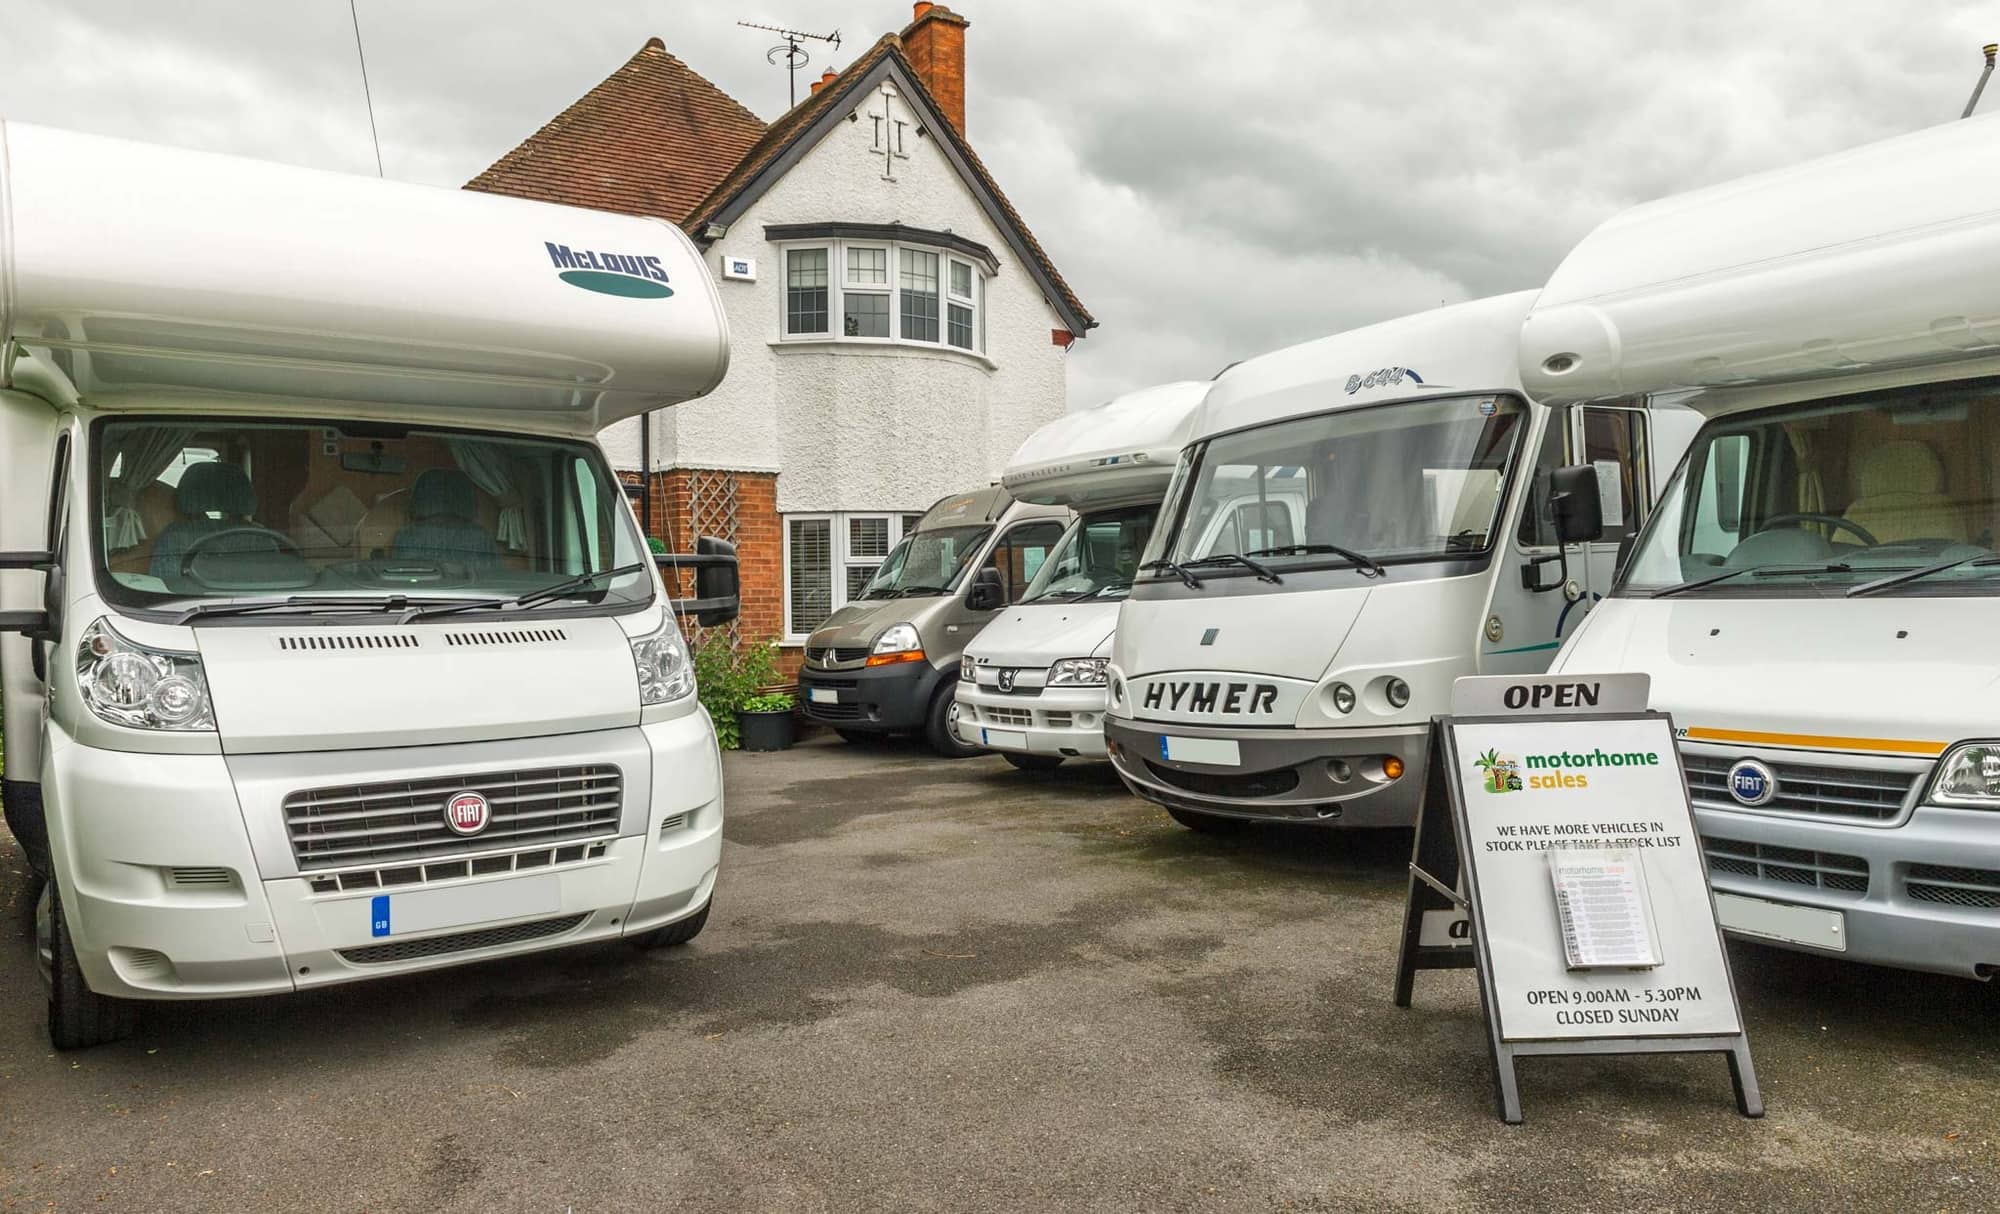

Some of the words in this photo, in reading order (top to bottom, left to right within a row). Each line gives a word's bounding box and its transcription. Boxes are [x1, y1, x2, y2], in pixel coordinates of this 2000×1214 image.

[544, 241, 669, 283] McLOUIS
[1144, 682, 1278, 713] HYMER
[1503, 683, 1600, 709] OPEN
[1526, 749, 1658, 769] motorhome
[1529, 770, 1588, 789] sales
[1735, 775, 1761, 790] FIAT
[457, 804, 480, 823] FIAT
[1497, 825, 1517, 836] WE
[1519, 825, 1551, 836] HAVE
[1554, 824, 1590, 835] MORE
[1592, 823, 1648, 834] VEHICLES
[1650, 822, 1664, 832] IN
[1486, 840, 1523, 852] STOCK
[1526, 840, 1569, 851] PLEASE
[1615, 837, 1655, 849] STOCK
[1656, 836, 1681, 847] LIST
[1527, 990, 1569, 1005] OPEN
[1572, 989, 1631, 1005] 9.00AM
[1644, 986, 1702, 1003] 5.30PM
[1556, 1009, 1614, 1025] CLOSED
[1619, 1008, 1680, 1024] SUNDAY
